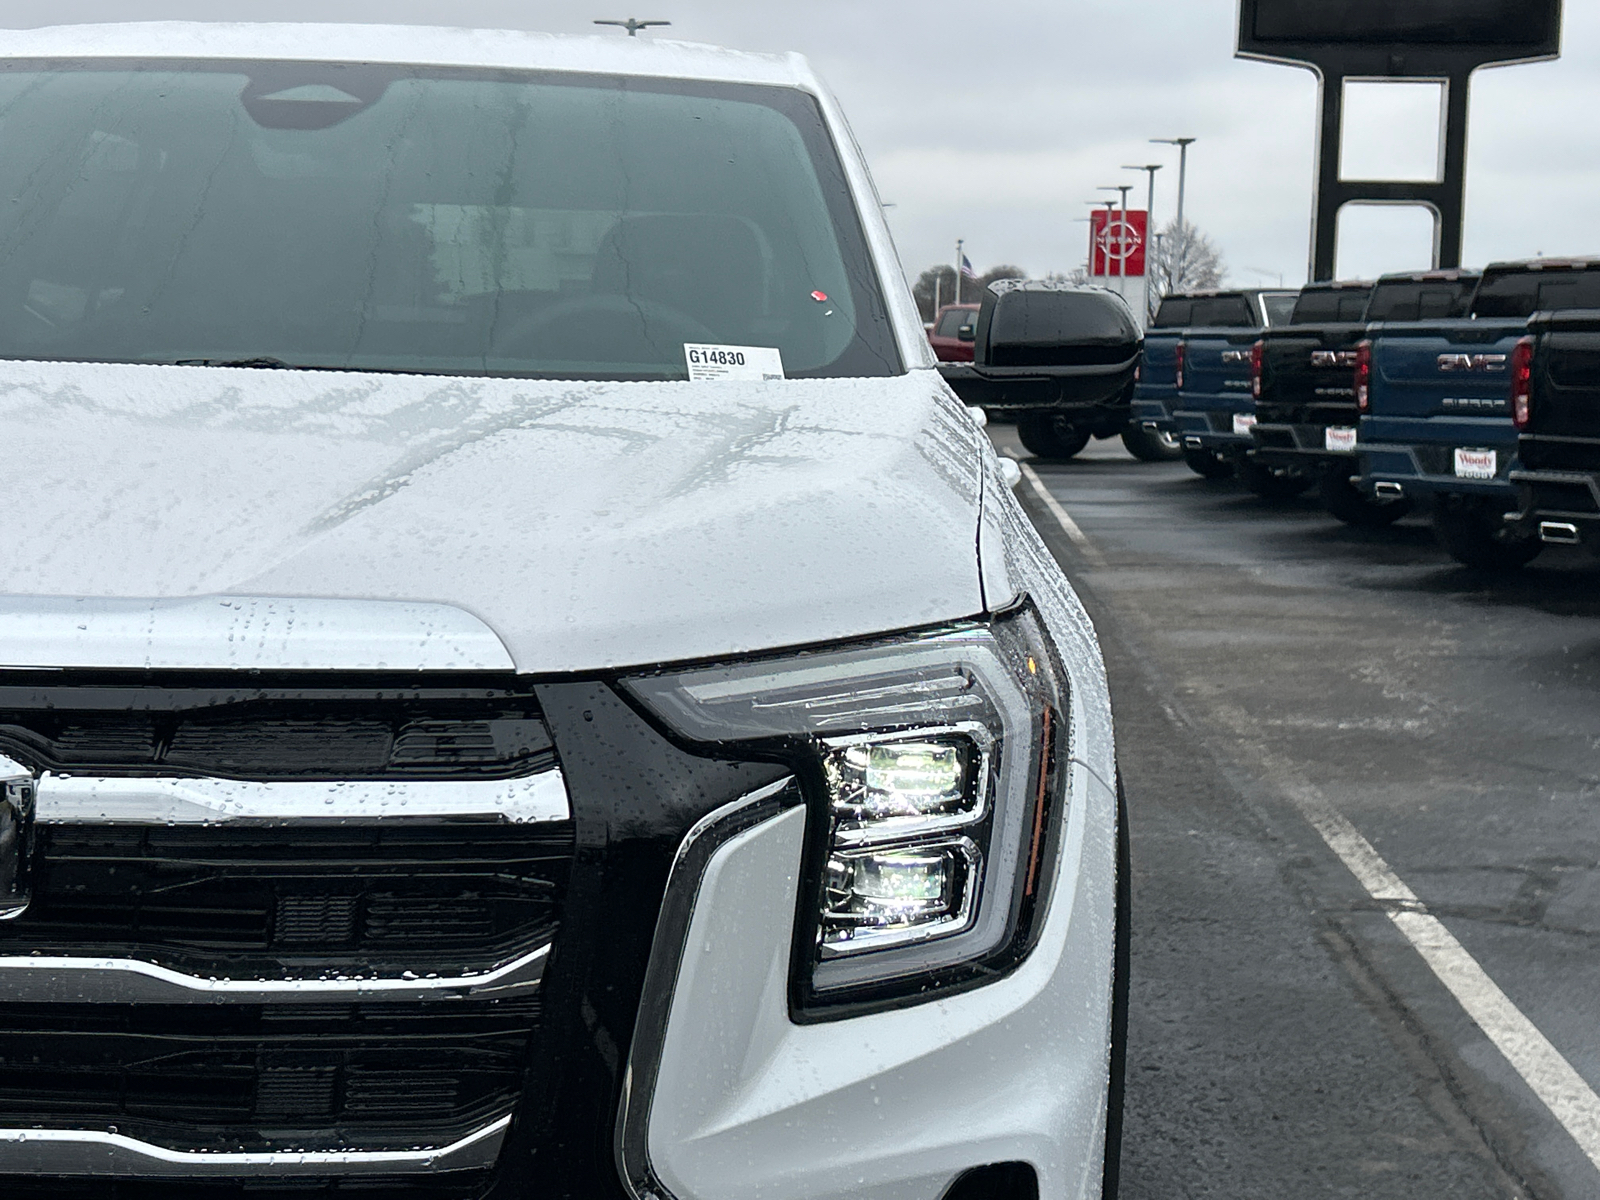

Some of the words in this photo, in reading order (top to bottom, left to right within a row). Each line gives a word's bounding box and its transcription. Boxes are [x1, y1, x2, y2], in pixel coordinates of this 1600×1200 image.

[1097, 236, 1142, 244] NSSAN
[689, 349, 746, 366] G14830
[1437, 353, 1507, 371] GMC
[1459, 453, 1492, 466] Woody
